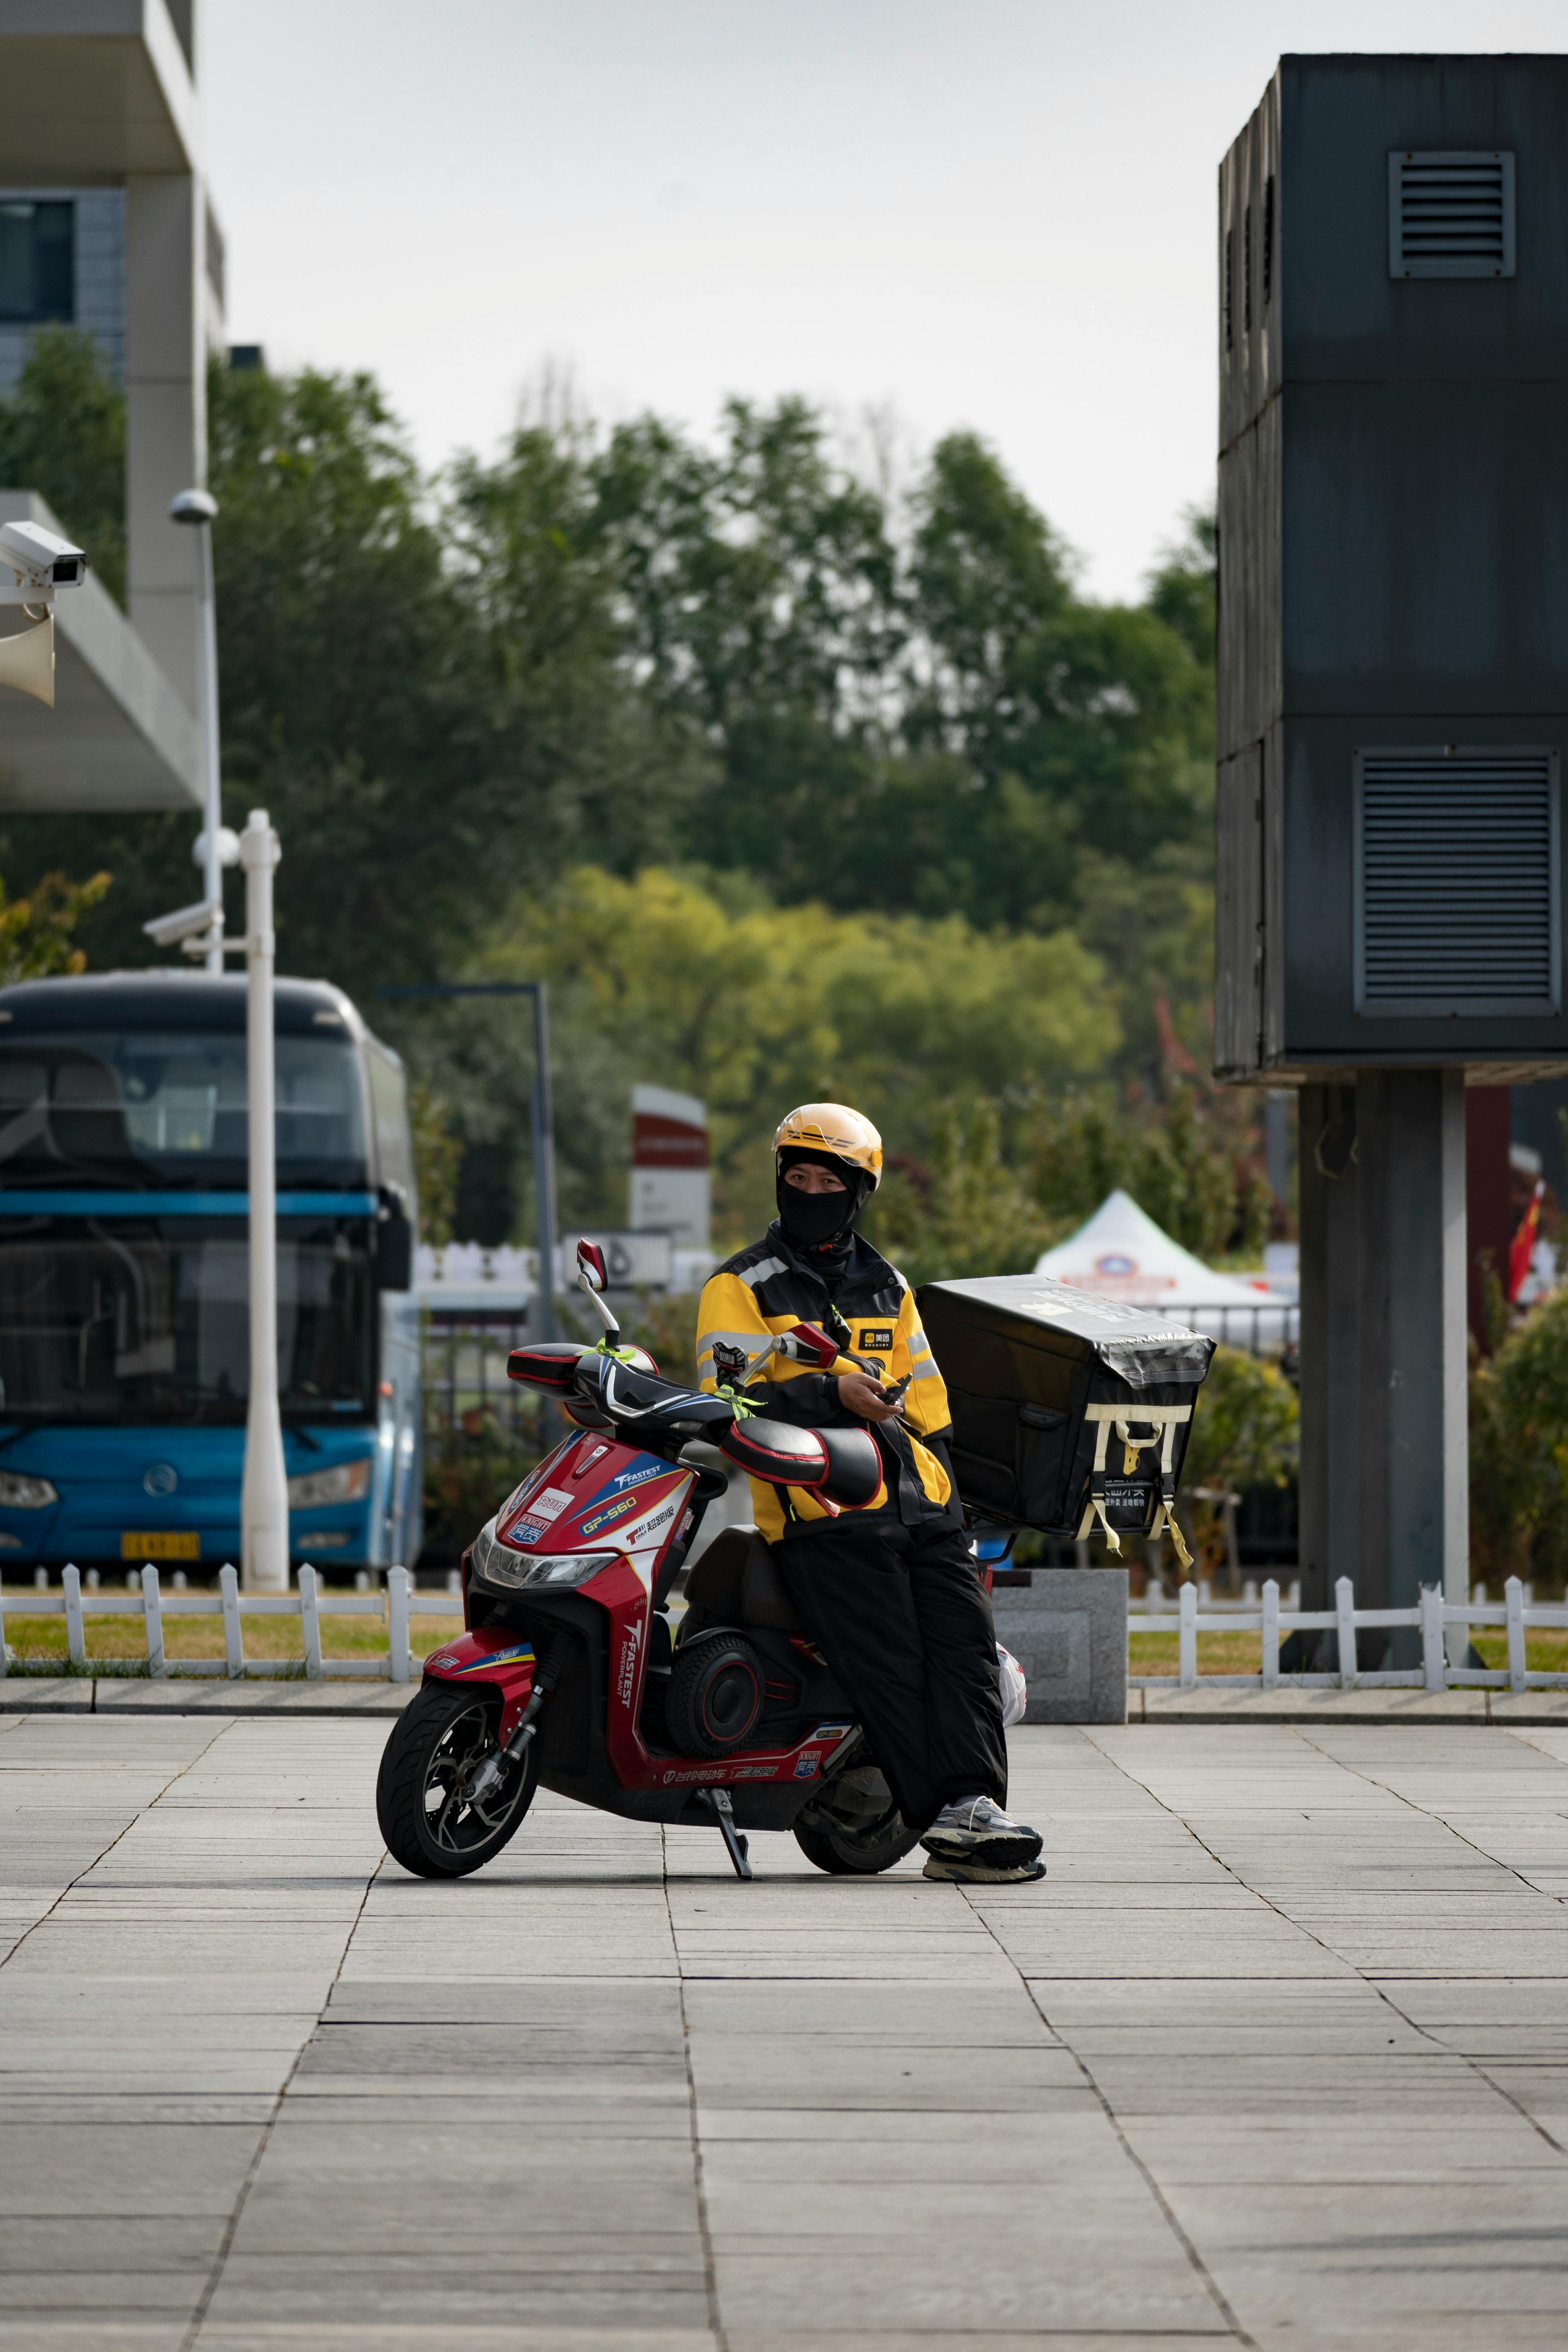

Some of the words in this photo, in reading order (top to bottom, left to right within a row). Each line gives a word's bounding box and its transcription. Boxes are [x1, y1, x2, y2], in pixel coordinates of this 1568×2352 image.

[875, 1334, 889, 1342] 美团
[615, 1465, 661, 1490] T-FASTEST
[628, 1473, 657, 1486] POWERPLANT
[537, 1496, 566, 1512] RUN
[1105, 1498, 1121, 1507] 团外卖
[521, 1514, 550, 1530] KNIGHT
[583, 1497, 637, 1534] GP-S60
[646, 1506, 675, 1533] 超跑版
[617, 1641, 628, 1696] POWERPLANT
[621, 1619, 642, 1708] T-FASTEST
[800, 1752, 820, 1760] KNIGHT
[675, 1769, 727, 1782] 台铃电动车
